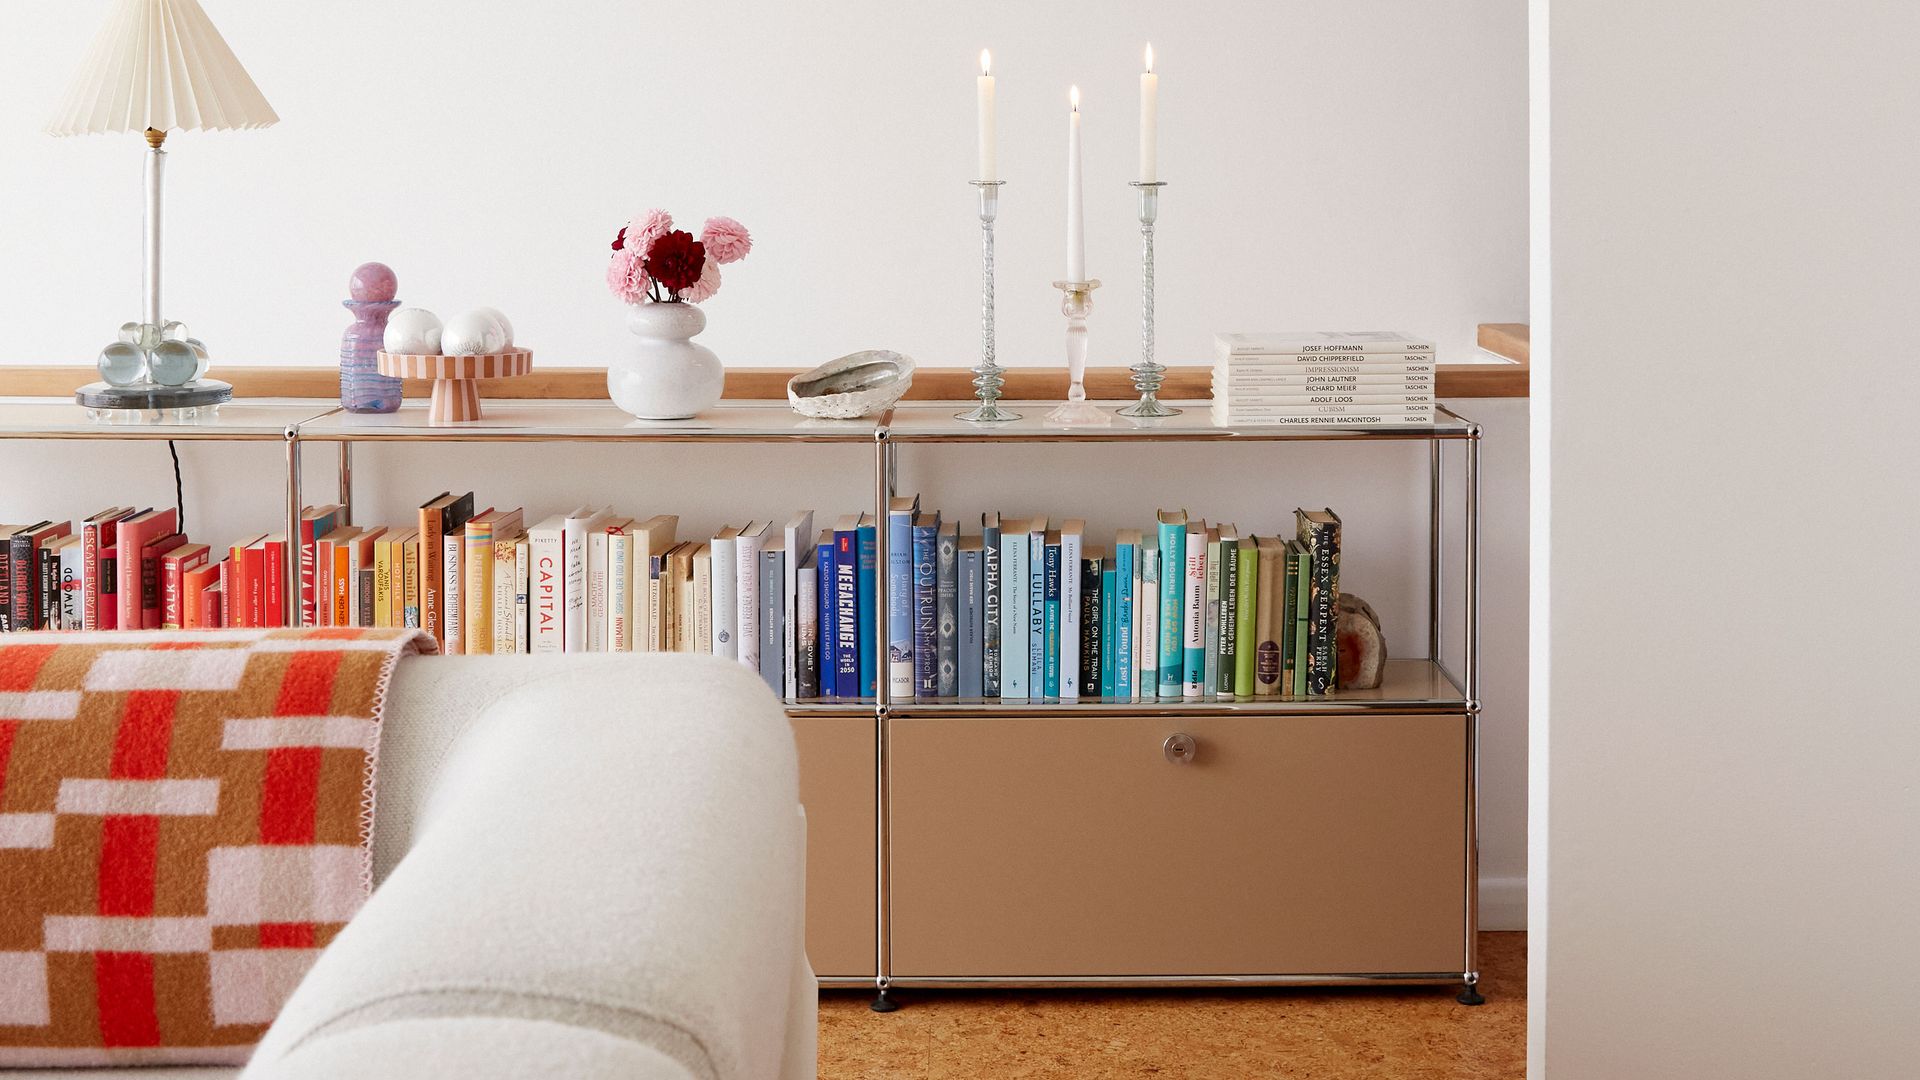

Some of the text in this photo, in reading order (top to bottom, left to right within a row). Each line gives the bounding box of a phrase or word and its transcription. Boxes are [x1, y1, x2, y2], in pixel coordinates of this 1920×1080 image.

[426, 520, 436, 582] Lady in Waiting
[1168, 534, 1176, 561] HOLLY
[86, 531, 96, 631] ESCAPE EVERYTHIN
[406, 549, 416, 602] Ali Smith
[1048, 548, 1058, 596] Tony Hawks
[1188, 556, 1196, 576] Still
[1210, 561, 1218, 593] The Bell Jar
[1320, 549, 1329, 584] ESSEX
[64, 568, 72, 616] ATWOOD
[167, 584, 176, 619] TALK
[427, 588, 436, 609] Anne
[448, 544, 458, 636] BUSINESS BOHEMIANS
[474, 553, 484, 618] PRETENDING
[540, 558, 553, 634] CAPITAL
[890, 574, 899, 617] Somebody
[902, 574, 910, 598] Diary
[902, 598, 909, 608] of
[920, 562, 934, 630] OUTRUN
[987, 546, 998, 626] ALPHA CITY
[742, 571, 753, 638] SVEN REGENER WIENER
[838, 564, 854, 648] MEGACHANGE
[1032, 574, 1042, 634] LULLABY
[1318, 590, 1328, 642] SERPENT
[503, 610, 514, 640] Splendid
[616, 618, 624, 648] UHLMANN
[807, 628, 813, 637] IN
[1091, 626, 1098, 638] ON
[1119, 627, 1128, 655] Found
[1165, 619, 1171, 629] ME
[1171, 621, 1178, 632] DO
[824, 642, 830, 650] ME
[825, 651, 830, 660] GO
[1119, 671, 1128, 687] Lost
